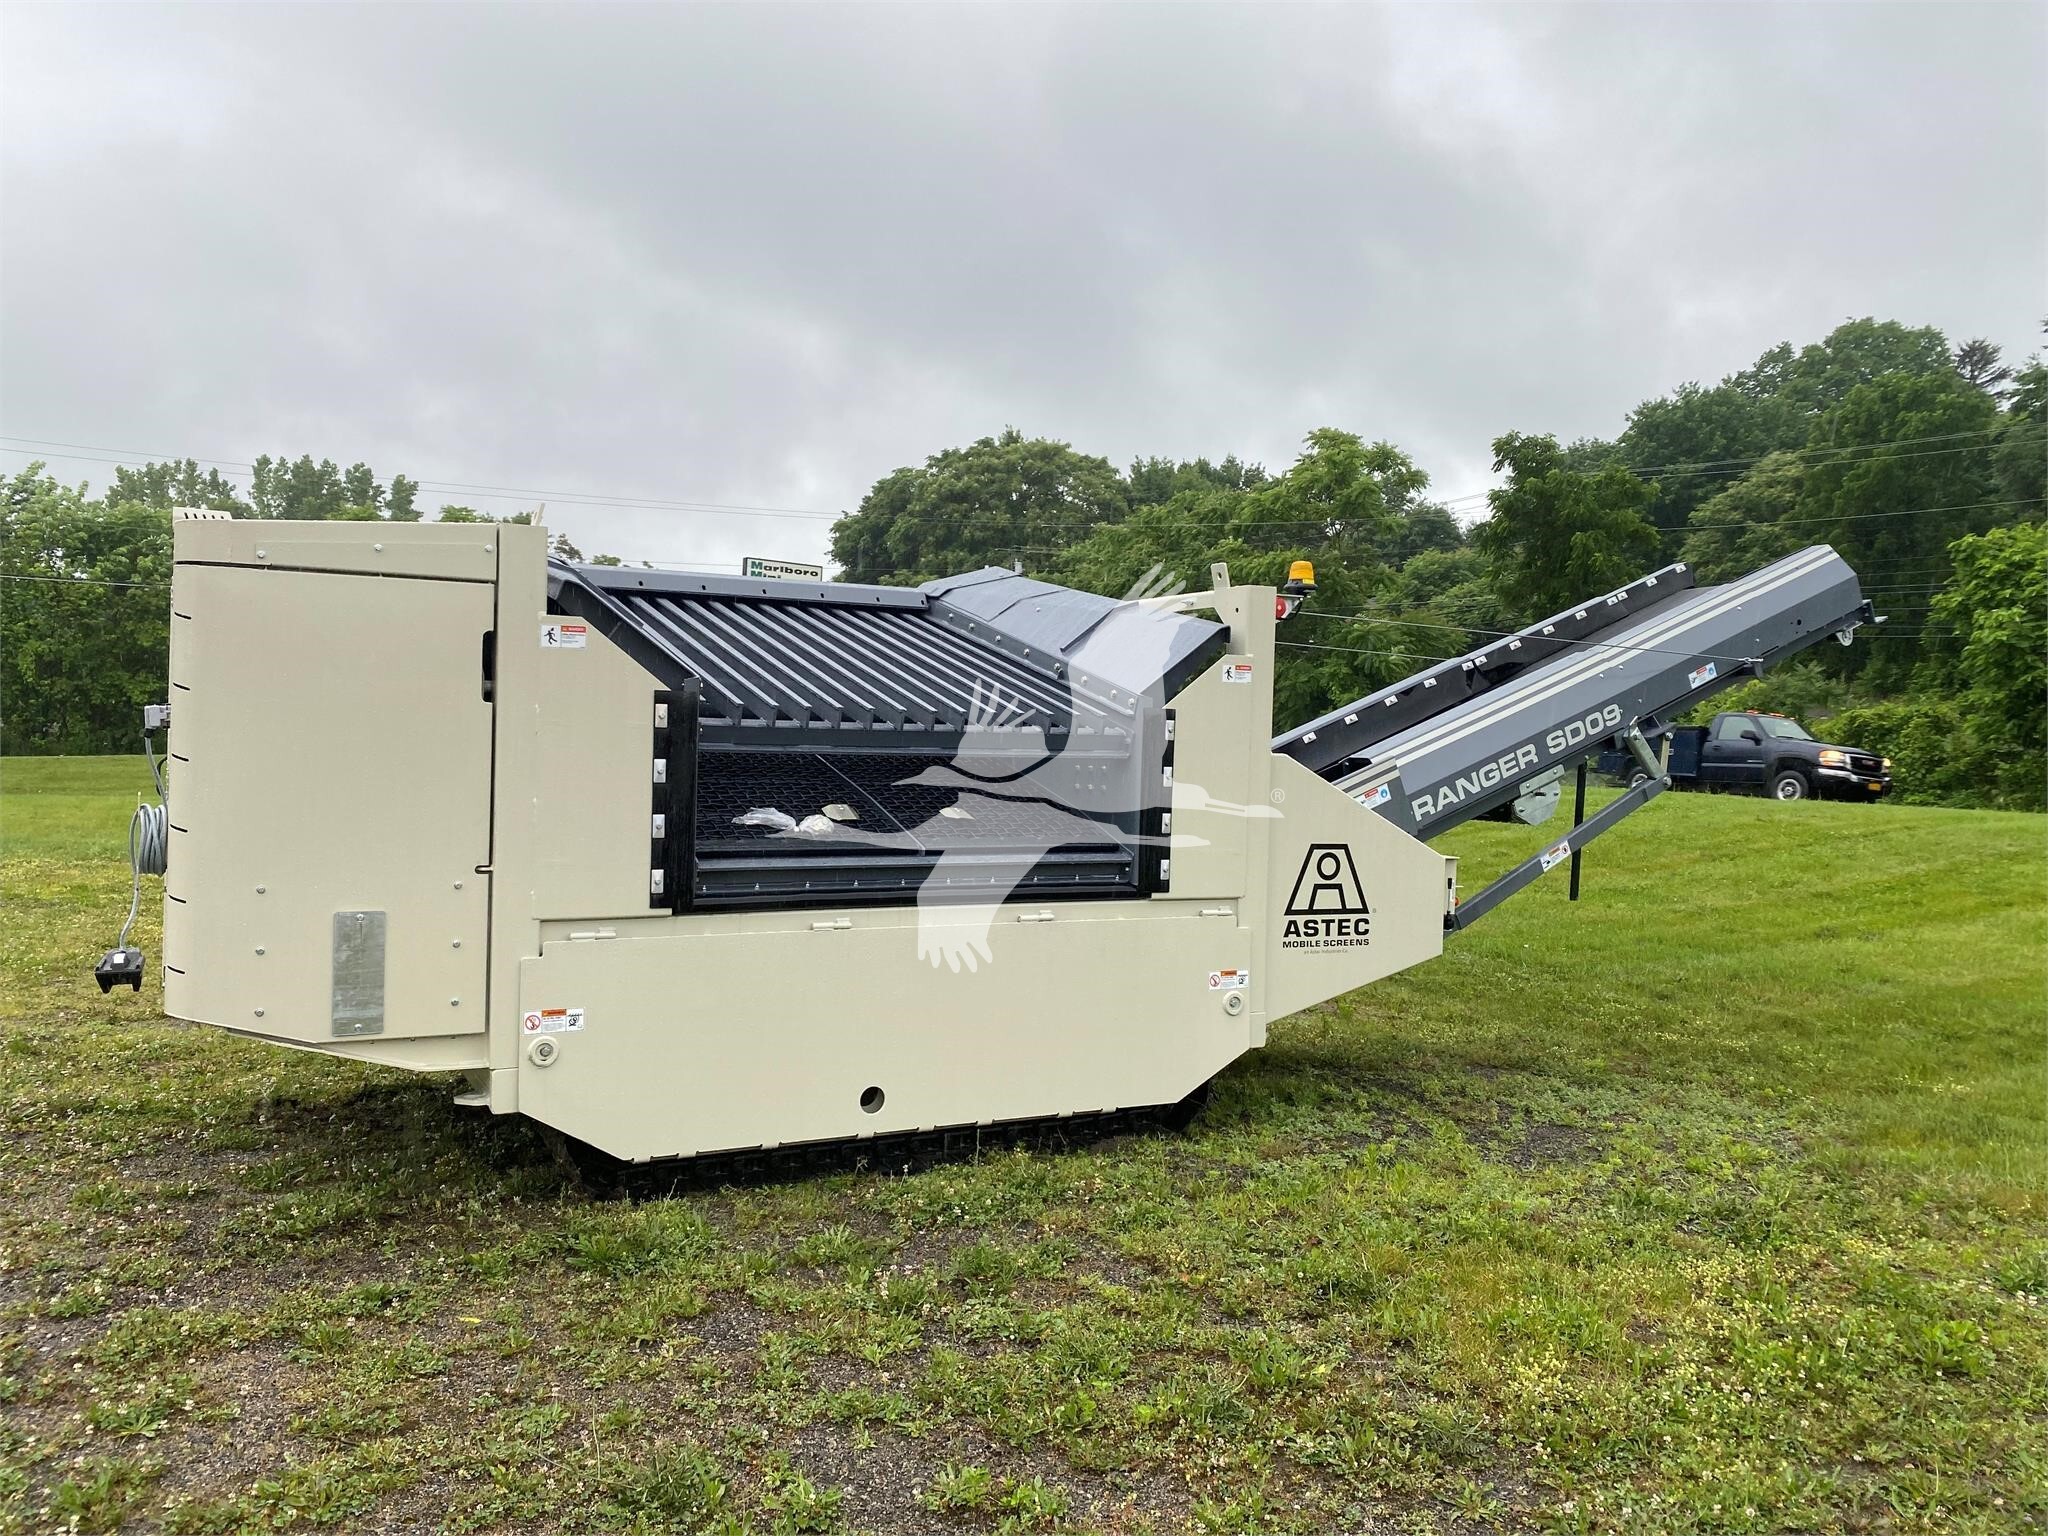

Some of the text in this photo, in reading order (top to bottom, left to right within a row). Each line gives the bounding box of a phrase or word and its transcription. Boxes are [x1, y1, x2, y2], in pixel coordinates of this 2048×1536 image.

[751, 561, 819, 577] Marlboro
[1411, 743, 1539, 822] RANGER
[1283, 918, 1370, 938] ASTEC
[1282, 938, 1370, 949] MOBILE SCREENS
